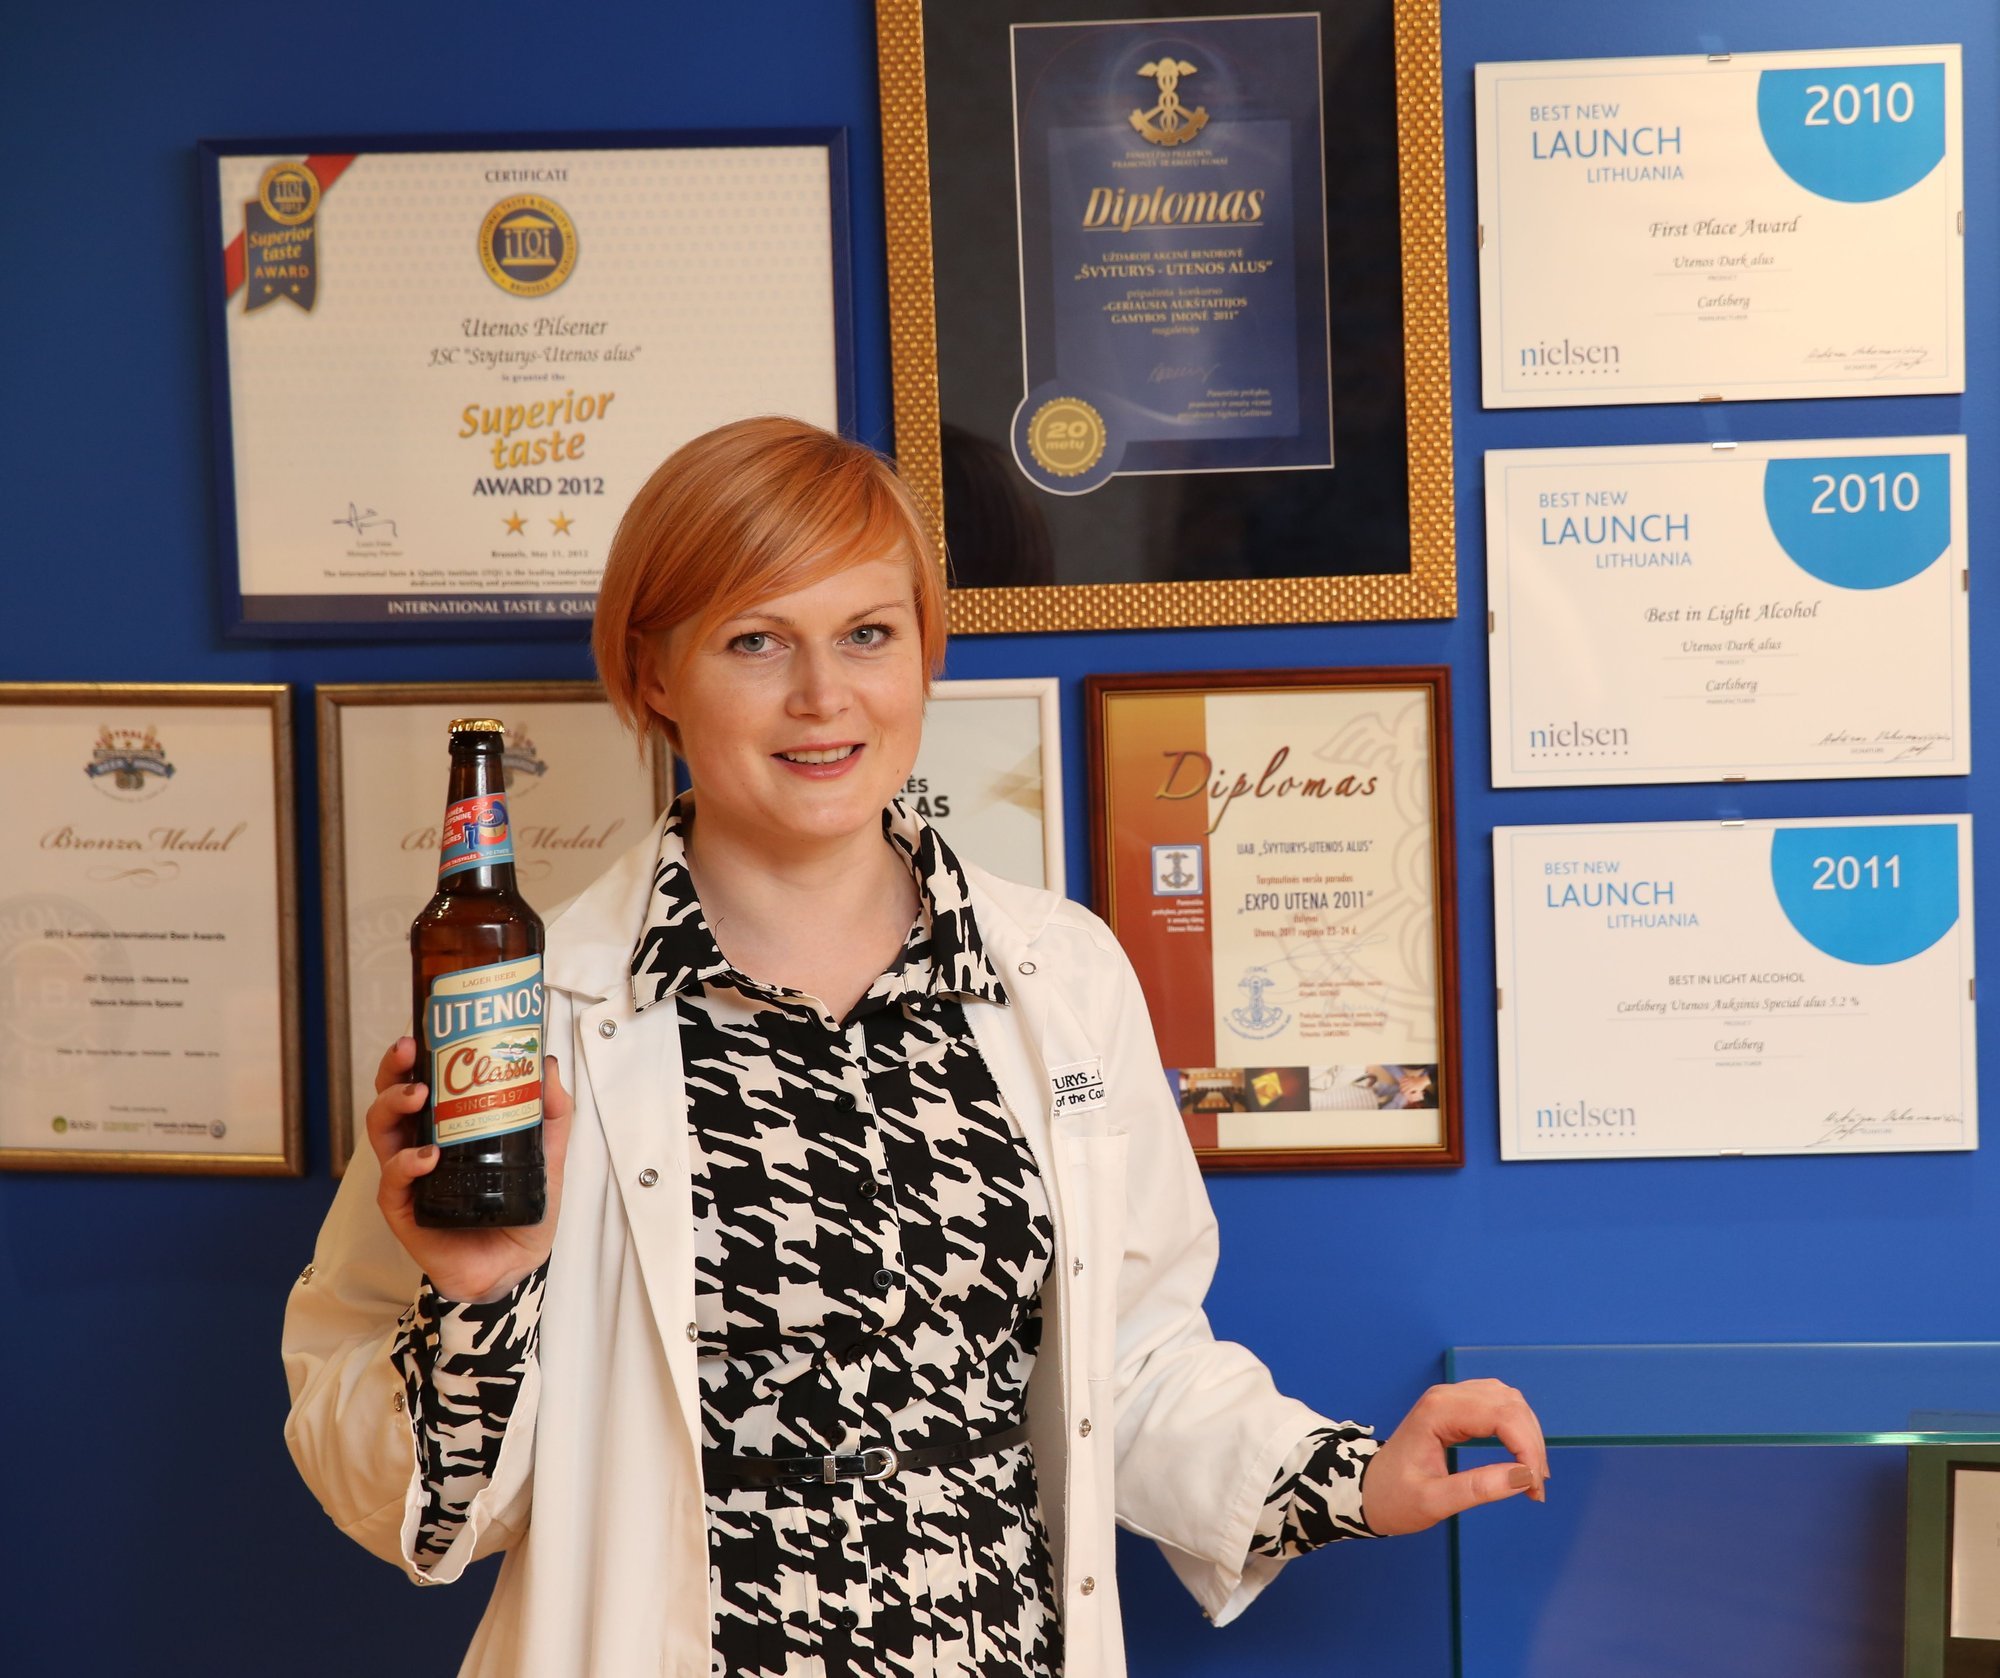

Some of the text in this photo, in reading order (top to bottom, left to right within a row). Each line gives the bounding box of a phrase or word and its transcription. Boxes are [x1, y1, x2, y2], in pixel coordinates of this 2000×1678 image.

[1530, 104, 1620, 122] BEST NEW
[1804, 81, 1915, 126] 2010
[1532, 126, 1682, 160] LAUNCH
[485, 169, 569, 183] CERTIFICATE
[1587, 166, 1684, 183] LITHUANIA
[1082, 186, 1265, 233] Diplomas
[250, 226, 314, 248] Superior
[1648, 215, 1803, 239] First Place Award
[263, 242, 302, 263] taste
[1672, 253, 1775, 270] Utenos Dark alus
[254, 265, 309, 278] AWARD
[1166, 261, 1225, 276] UTENOS
[1697, 293, 1750, 311] Carlsberg
[461, 315, 607, 338] Utenos Pilsener
[1520, 338, 1620, 367] nielsen
[458, 388, 615, 439] Superior
[1047, 420, 1088, 439] 20
[491, 430, 586, 470] taste
[472, 476, 604, 496] AWARD 2012
[1811, 471, 1920, 514] 2010
[1538, 491, 1628, 508] BEST NEW
[1542, 514, 1689, 545] LAUNCH
[1596, 552, 1692, 569] LITHUANIA
[388, 599, 500, 614] INTERNATIONAL
[503, 599, 543, 613] TASTE
[545, 600, 556, 613] &
[1644, 600, 1820, 626] Best in Light Alcohol
[1681, 638, 1781, 654] Utenos Dark alus
[1705, 676, 1759, 694] Carlsberg
[1530, 720, 1629, 748] nielsen
[1155, 746, 1378, 835] Diplomas
[40, 821, 248, 851] Bronze Medal
[518, 818, 625, 851] Medal
[1237, 842, 1255, 855] UAB
[1544, 861, 1620, 877] BEST NEW
[1812, 854, 1900, 890] 2011
[1285, 890, 1328, 911] UTENA
[1546, 881, 1674, 908] LAUNCH
[1607, 913, 1698, 930] LITHUANIA
[462, 970, 517, 989] LAGER BEER
[1668, 972, 1805, 986] BEST IN LIGHT ALCOHOL
[433, 981, 543, 1039] UTENOS
[1617, 998, 1666, 1015] Carlsberg
[1671, 998, 1709, 1012] Utenos
[1762, 995, 1801, 1011] Special
[1804, 995, 1826, 1009] alus
[1714, 1037, 1764, 1053] Carlsberg
[444, 1047, 534, 1096] Classic
[1052, 1072, 1088, 1090] URYS
[456, 1094, 497, 1114] SINCE
[1056, 1095, 1065, 1108] of
[1068, 1093, 1086, 1105] the
[1537, 1101, 1635, 1128] nielsen
